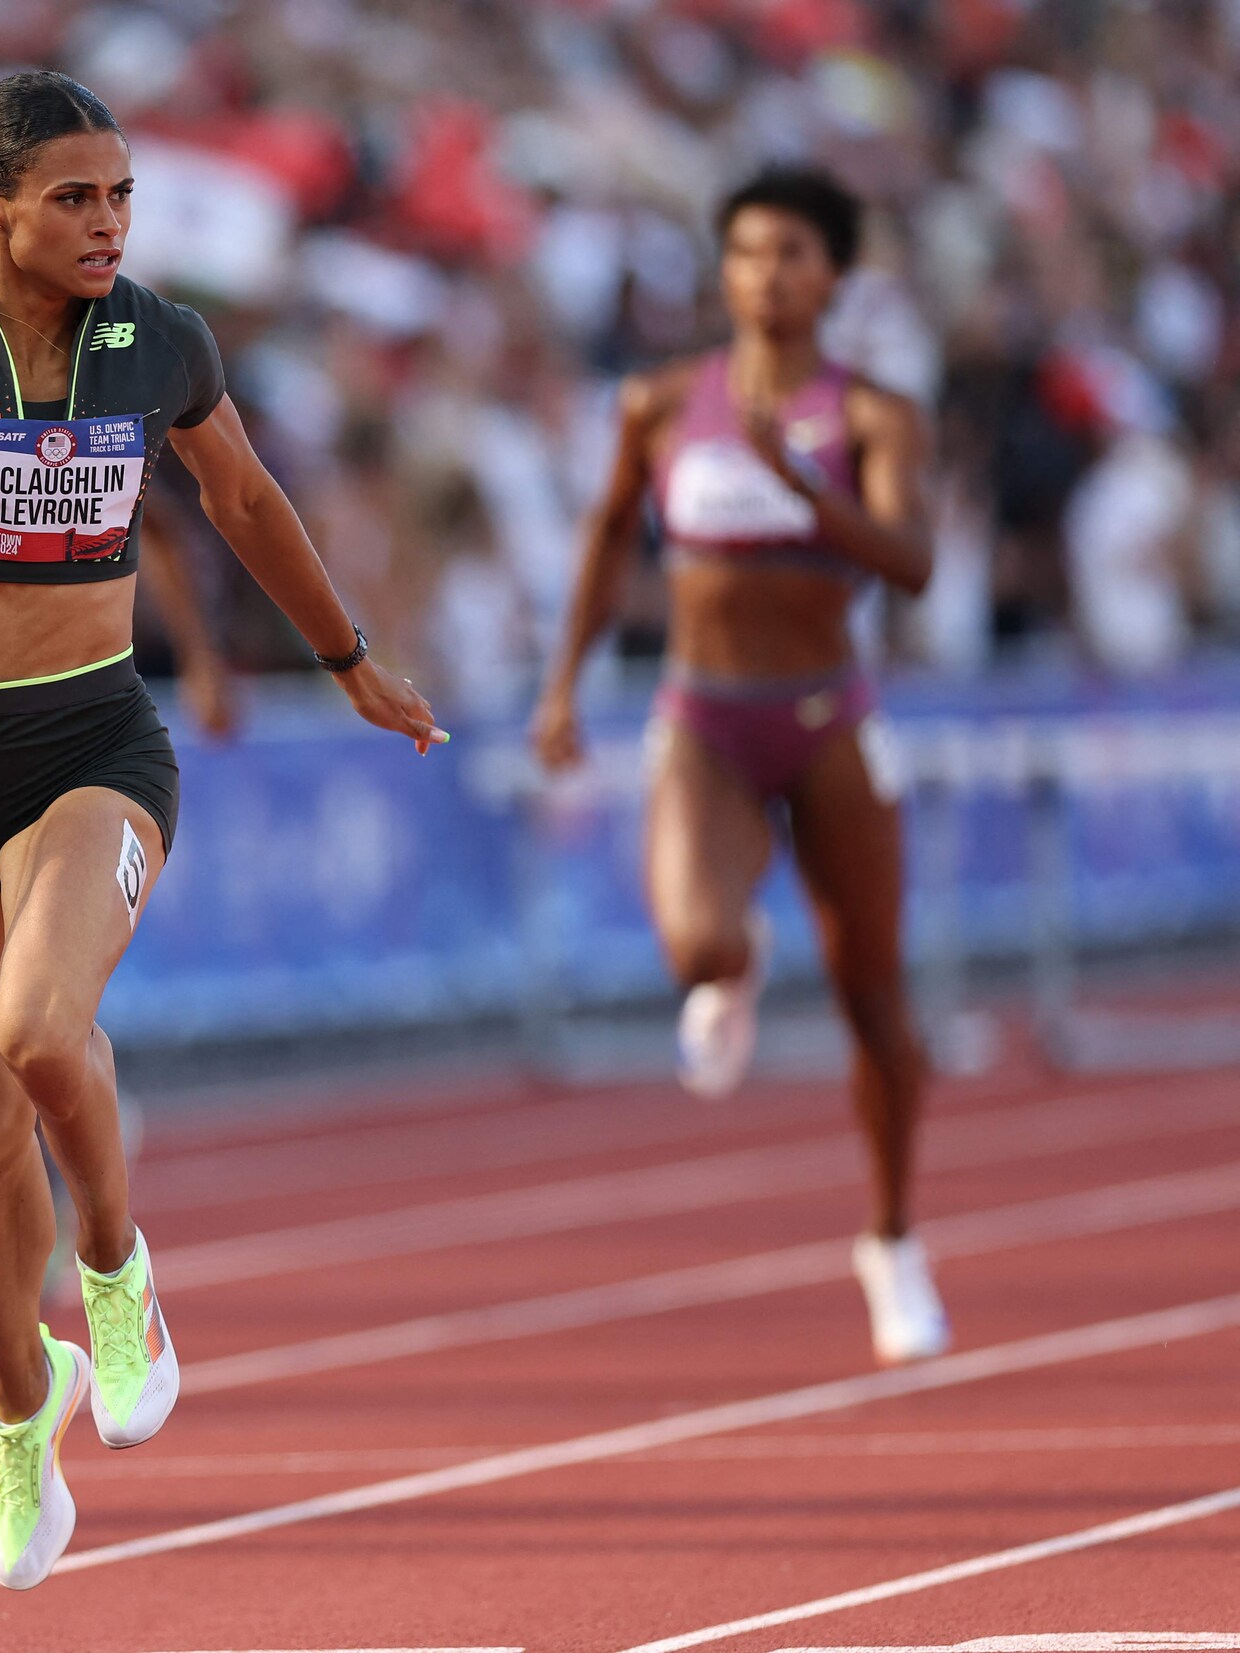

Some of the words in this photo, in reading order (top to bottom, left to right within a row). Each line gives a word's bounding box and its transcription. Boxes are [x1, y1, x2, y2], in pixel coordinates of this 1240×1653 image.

[90, 425, 103, 435] U.S.
[105, 421, 134, 433] OLYMPIC
[90, 435, 109, 445] TEAM
[111, 432, 135, 443] TRIALS
[90, 445, 106, 453] TRACK
[111, 443, 125, 452] FIELD
[0, 497, 103, 525] LEVRONE
